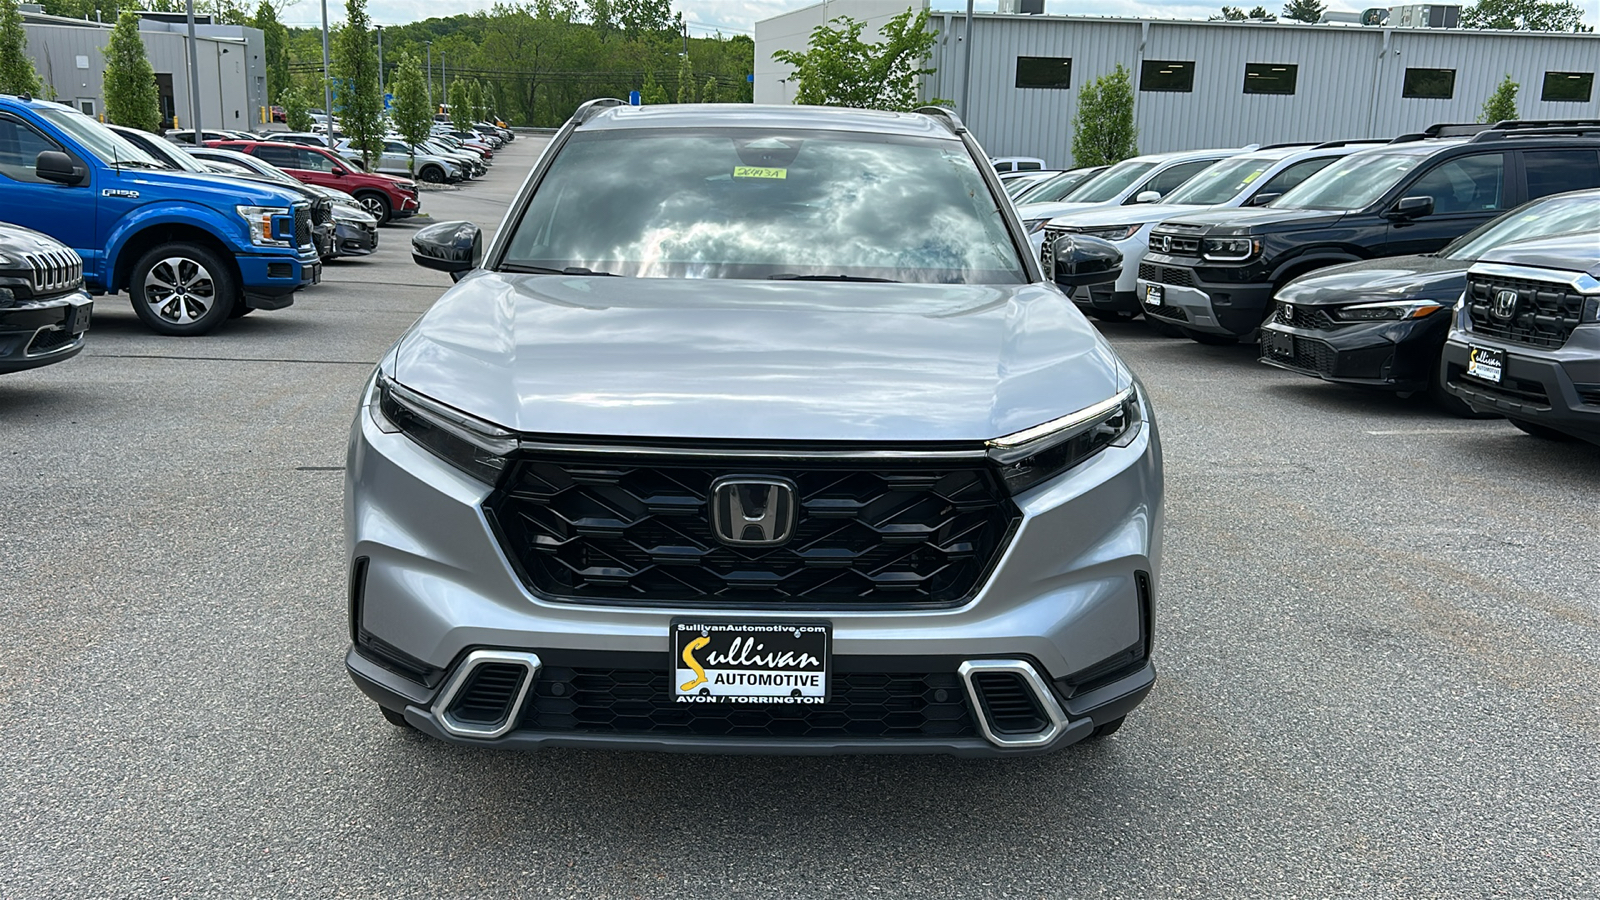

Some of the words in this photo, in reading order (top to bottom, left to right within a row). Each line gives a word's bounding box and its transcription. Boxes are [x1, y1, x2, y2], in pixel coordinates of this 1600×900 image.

[677, 624, 826, 633] SullivanAutomotive.com
[680, 636, 820, 692] Sullivan
[714, 673, 819, 687] AUTOMOTIVE
[676, 695, 717, 703] AVON
[728, 696, 825, 704] TORRINGTON
